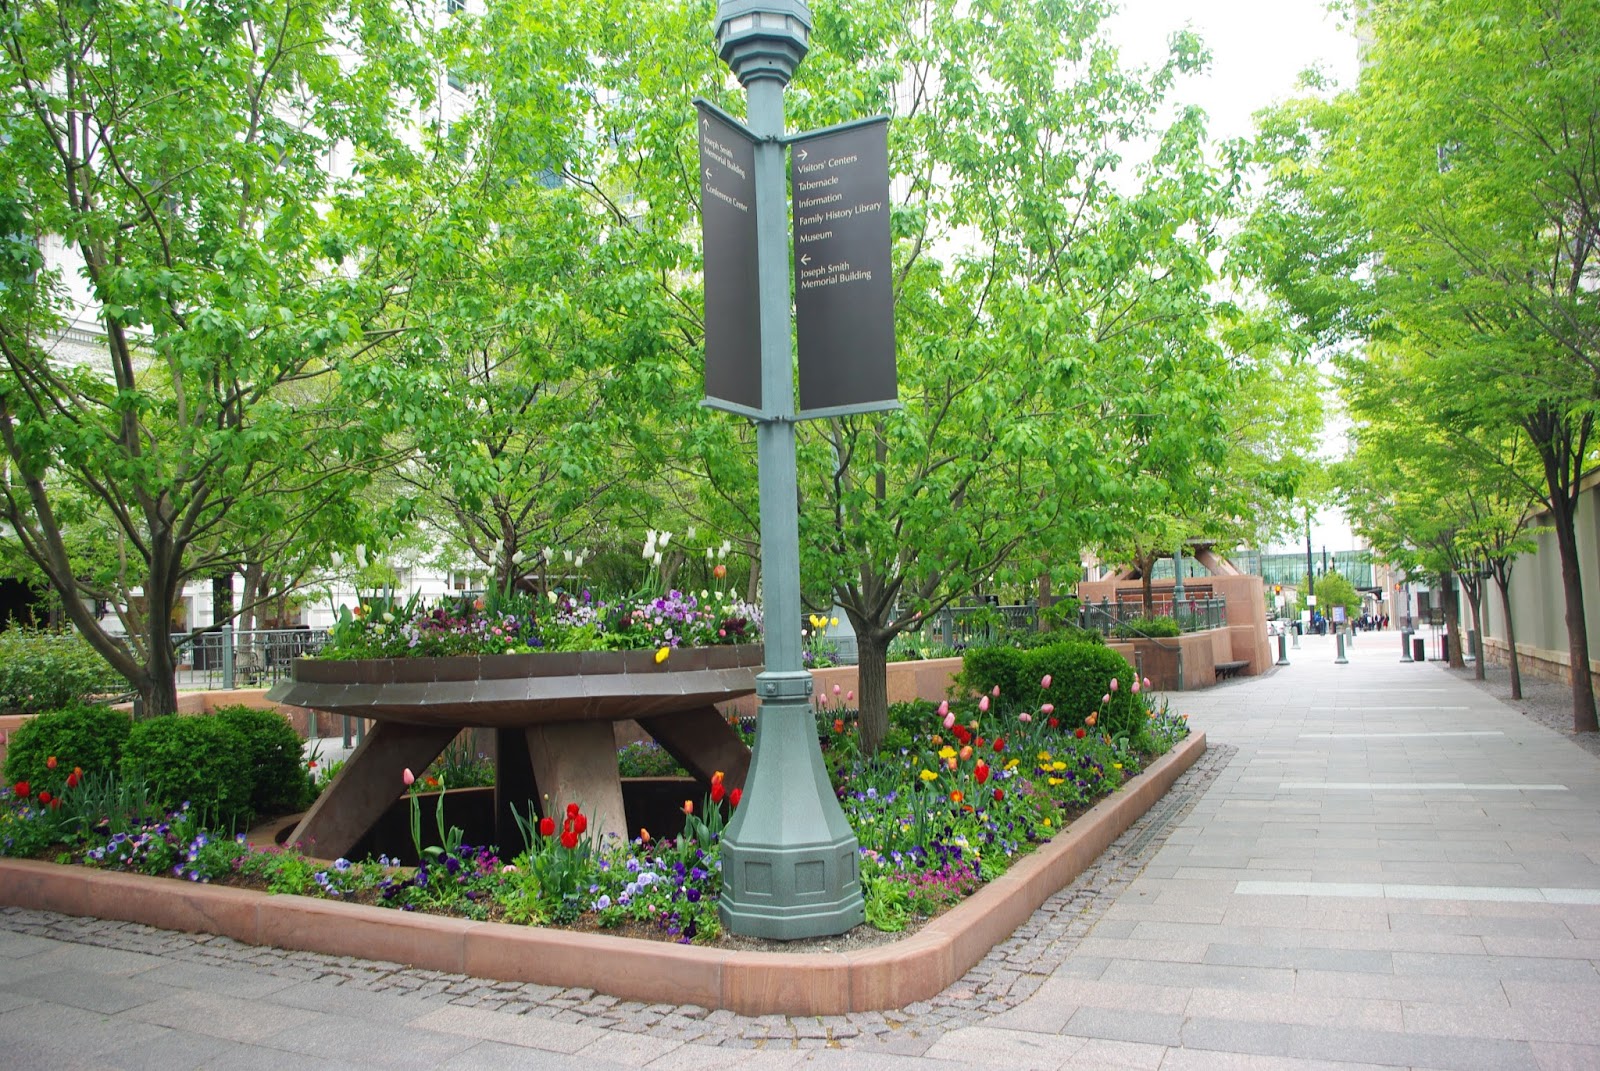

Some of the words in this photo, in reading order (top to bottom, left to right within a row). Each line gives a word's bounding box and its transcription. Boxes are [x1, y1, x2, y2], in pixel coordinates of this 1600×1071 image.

[828, 154, 858, 168] Centers
[798, 175, 839, 192] Tabernacle
[705, 182, 733, 205] Conference
[732, 197, 749, 213] Center
[798, 193, 843, 209] Information
[799, 213, 824, 226] Family
[825, 208, 853, 220] History
[854, 202, 882, 215] Library
[799, 230, 833, 243] Museum
[801, 266, 826, 279] Joseph
[828, 261, 850, 273] Smith
[801, 274, 838, 289] Memorial
[839, 270, 872, 283] Building
